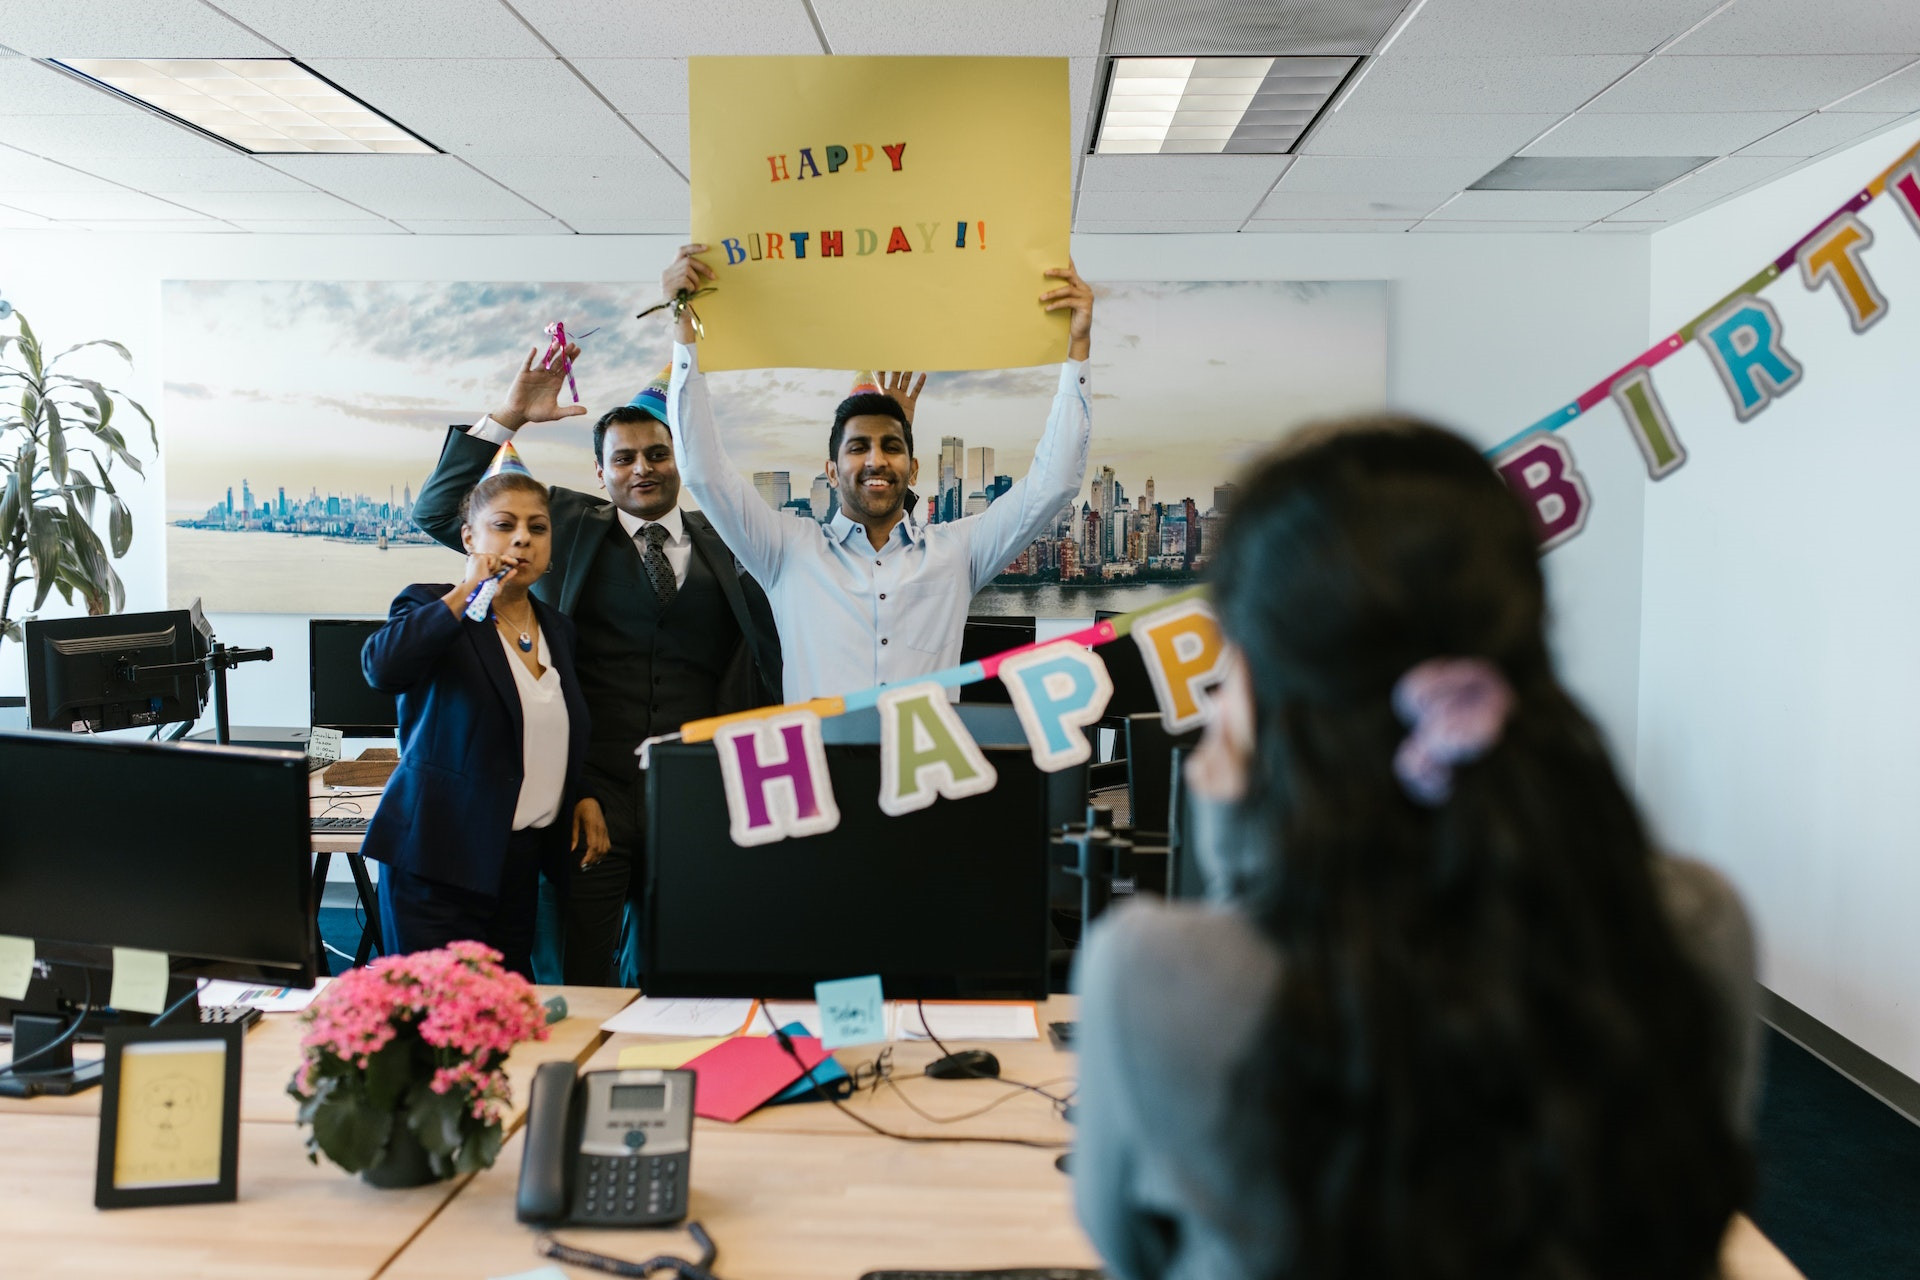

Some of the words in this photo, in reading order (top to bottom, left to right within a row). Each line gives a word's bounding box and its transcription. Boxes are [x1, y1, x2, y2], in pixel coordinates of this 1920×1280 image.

[766, 142, 907, 183] HAPPY
[1488, 165, 1920, 553] BIRT
[722, 605, 1228, 840] HAPP
